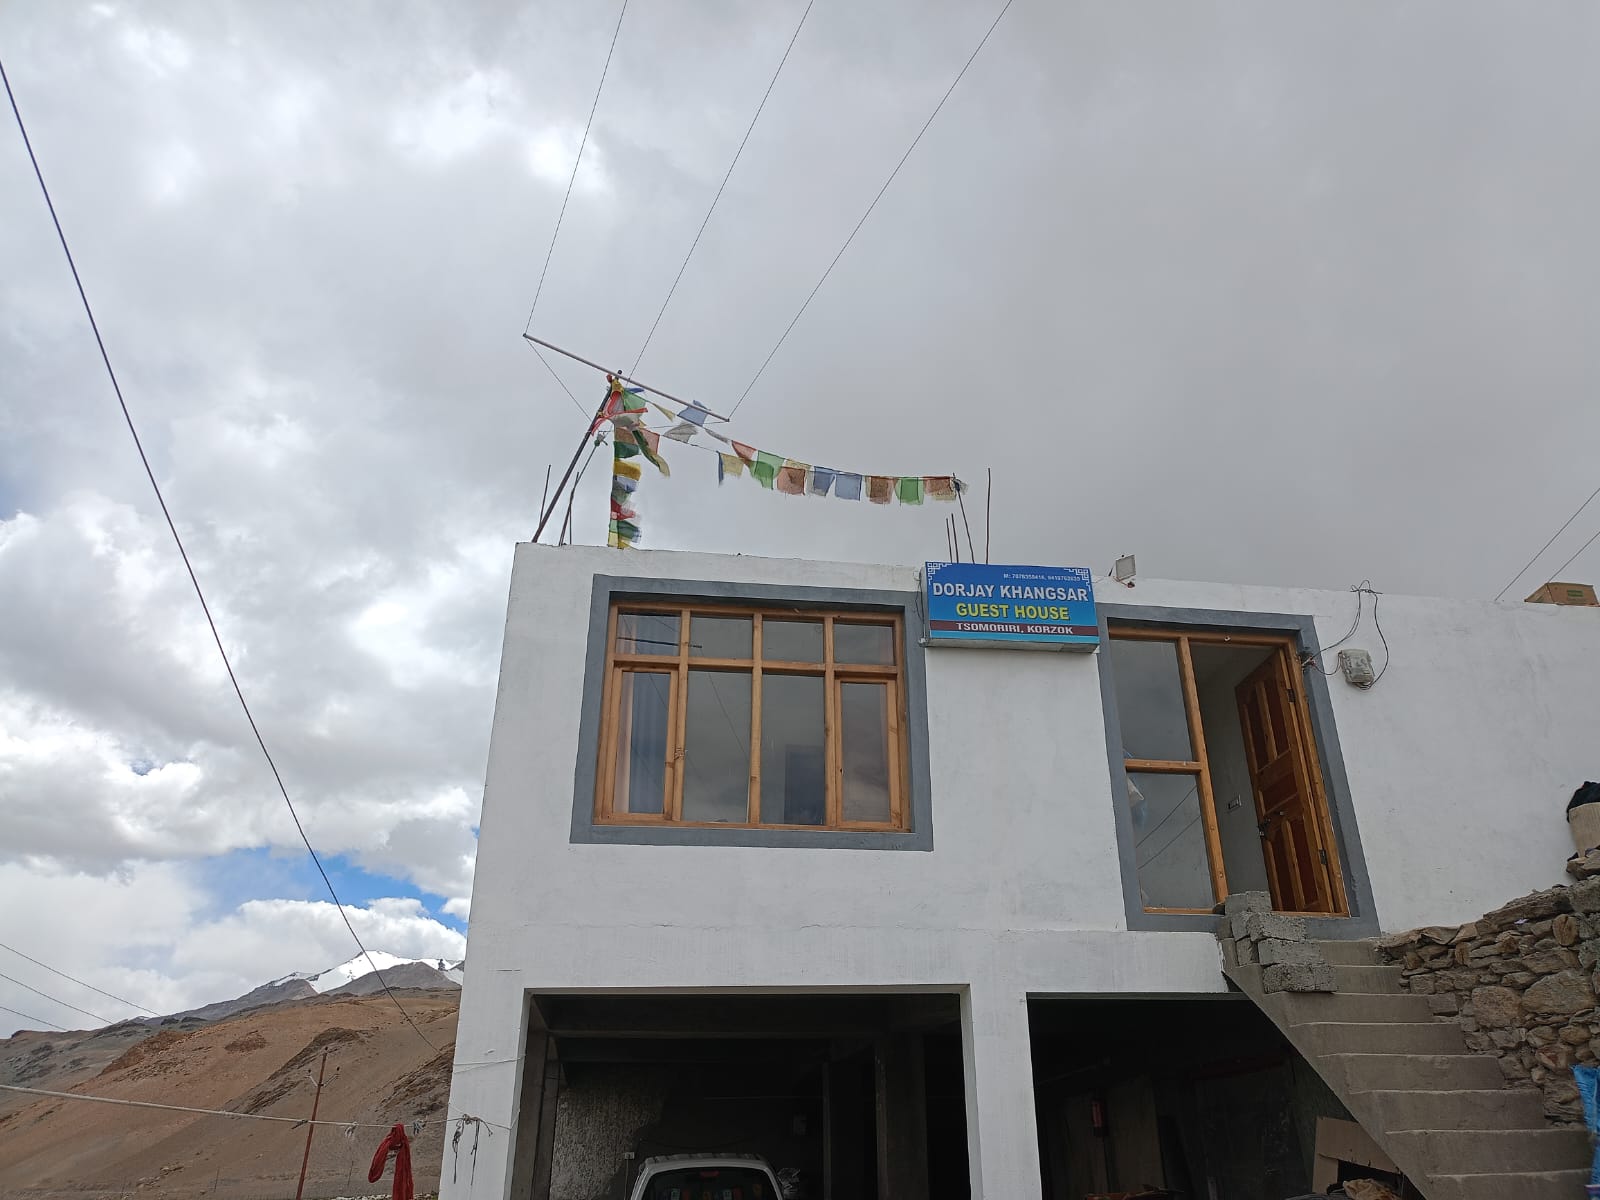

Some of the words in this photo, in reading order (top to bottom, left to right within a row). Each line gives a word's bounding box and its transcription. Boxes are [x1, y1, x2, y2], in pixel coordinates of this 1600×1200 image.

[932, 582, 995, 598] DORJAY
[1000, 585, 1089, 602] KHANGSAR
[956, 602, 1009, 618] GUEST
[1014, 605, 1070, 620] HOUSE
[1027, 626, 1073, 635] KORZOK
